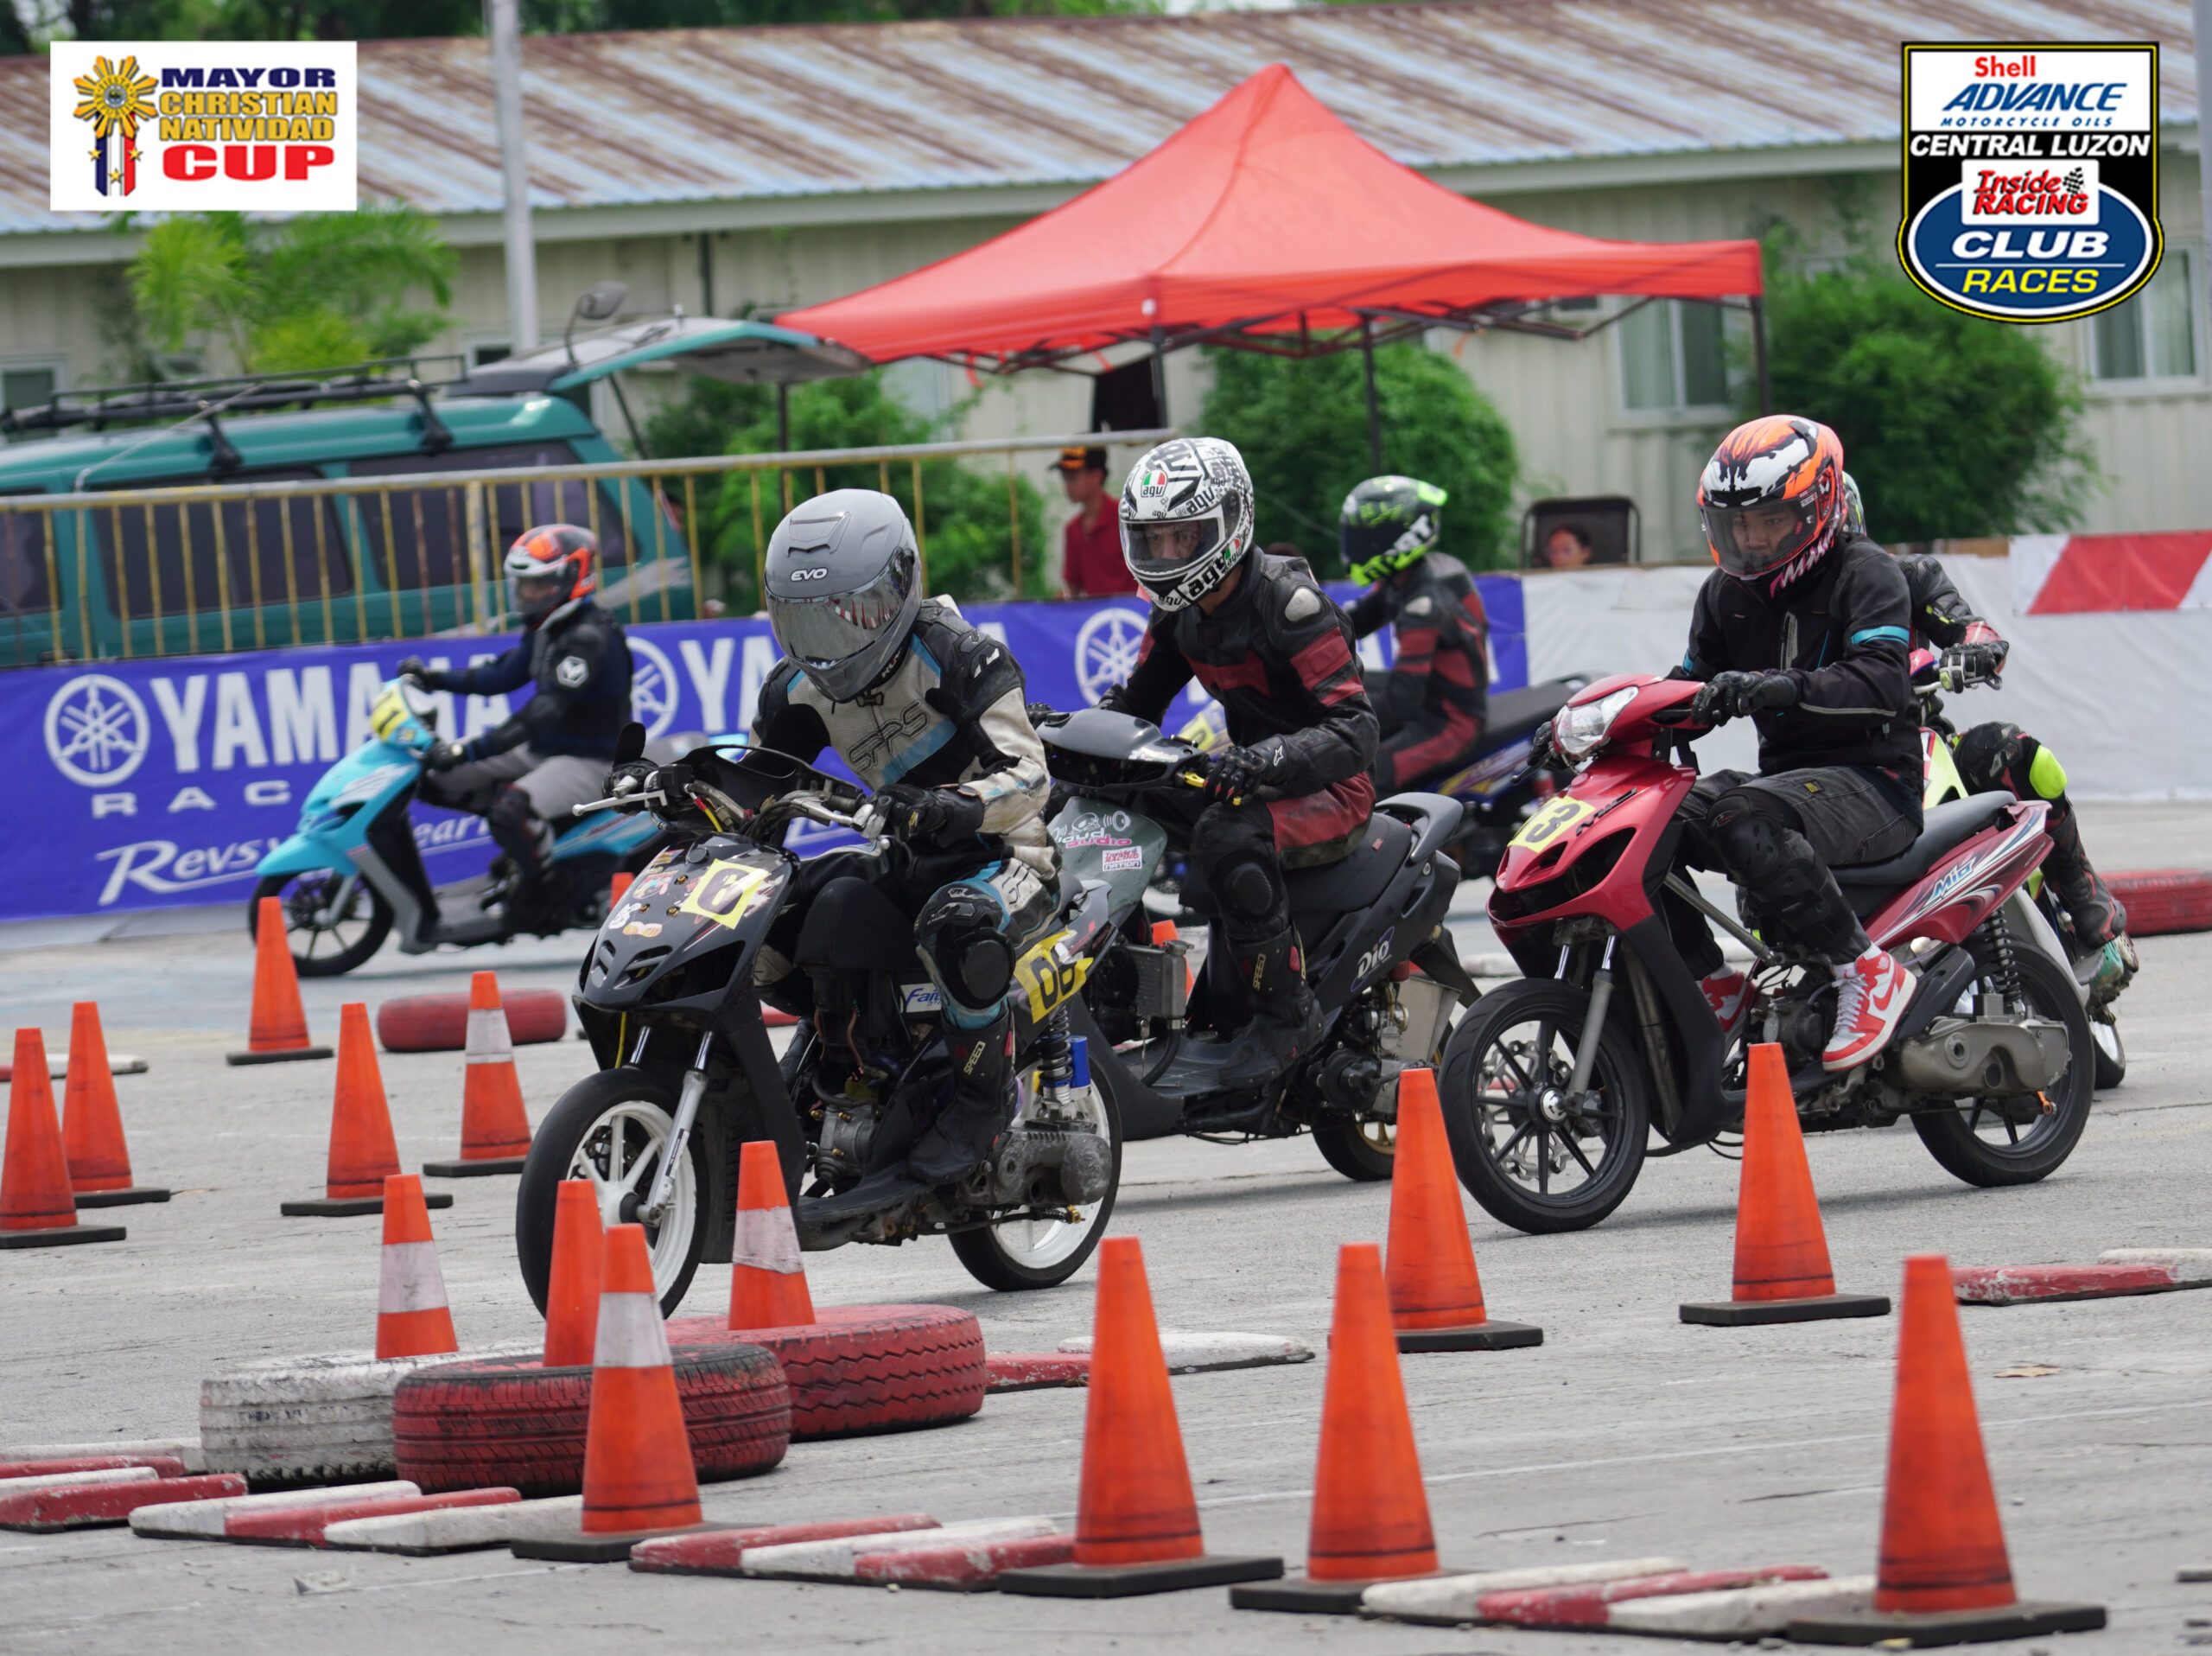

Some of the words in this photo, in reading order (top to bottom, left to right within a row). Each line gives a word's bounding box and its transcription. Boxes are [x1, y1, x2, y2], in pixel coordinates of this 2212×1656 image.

[1142, 486, 1164, 498] agv
[1186, 486, 1215, 513] agv
[790, 566, 829, 582] EVO
[92, 780, 292, 818] RAC
[95, 839, 264, 906] Revs
[1928, 856, 1977, 902] Mio
[1253, 952, 1267, 991] SPEED
[963, 1041, 986, 1075] SPEED
